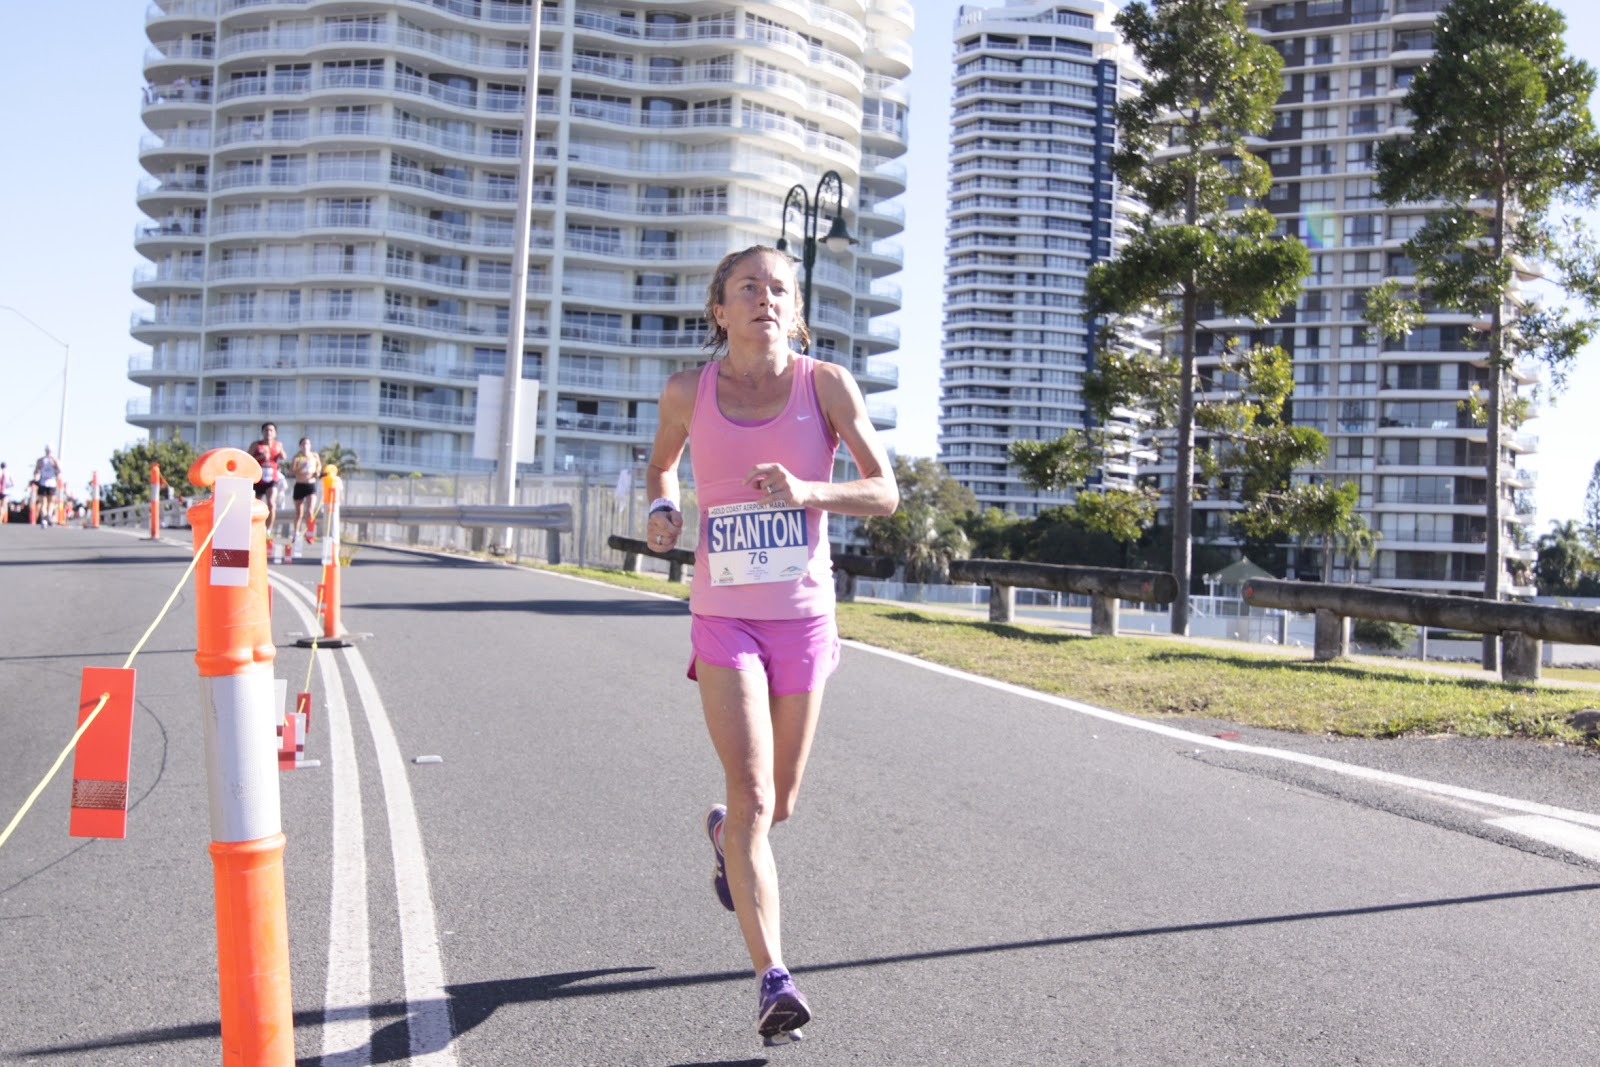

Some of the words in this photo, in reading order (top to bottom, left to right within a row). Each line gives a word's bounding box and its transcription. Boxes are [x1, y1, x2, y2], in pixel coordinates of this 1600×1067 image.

[713, 506, 726, 515] GOLD
[726, 504, 742, 514] COAST
[712, 511, 803, 552] STANTON
[748, 551, 768, 565] 76
